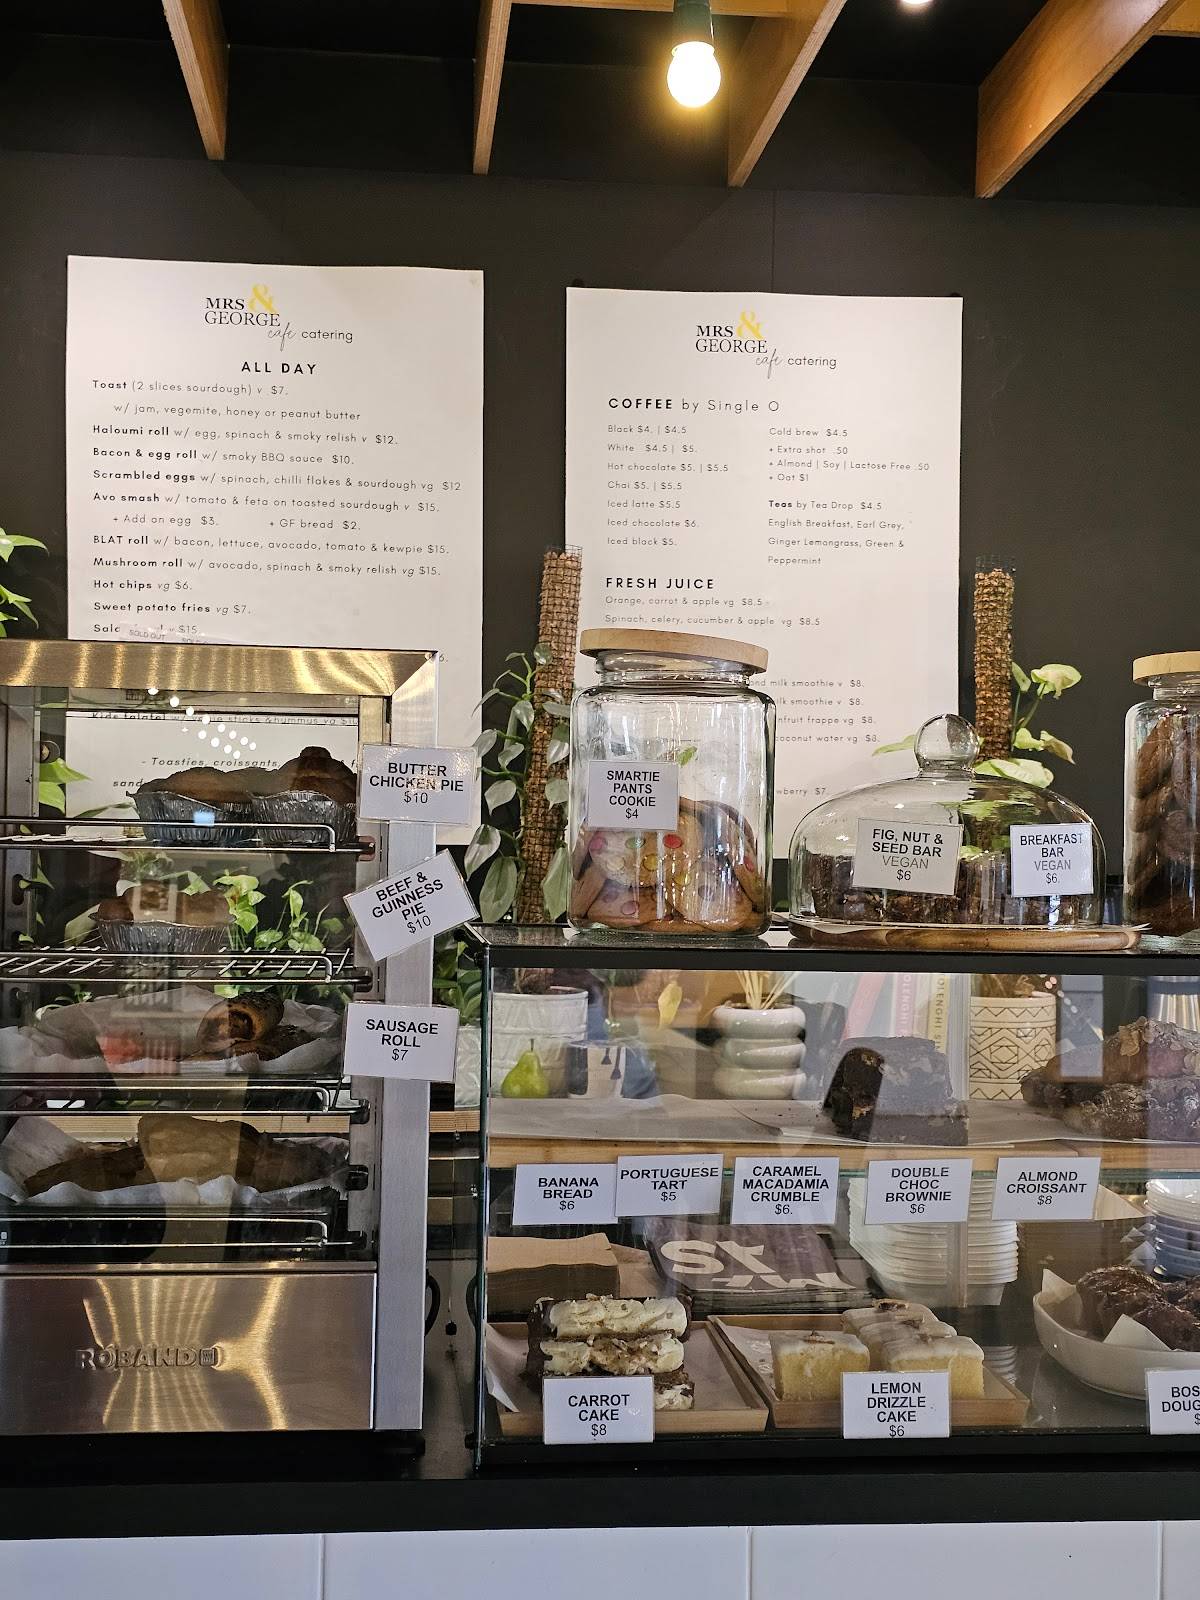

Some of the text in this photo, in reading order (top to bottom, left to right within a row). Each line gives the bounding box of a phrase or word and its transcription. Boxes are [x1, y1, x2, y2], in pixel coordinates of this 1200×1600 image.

[206, 284, 279, 313] MRS &
[204, 312, 280, 327] GEORGE
[696, 310, 764, 340] MRS &
[301, 328, 353, 343] catering
[695, 340, 768, 354] GEORGE
[240, 360, 318, 376] ALL DAY
[787, 355, 837, 369] catering
[92, 379, 128, 390] Toast
[132, 380, 143, 393] (2
[148, 379, 182, 393] slices
[186, 382, 252, 398] sourdough)
[608, 395, 780, 417] COFFEE by Single O
[92, 424, 144, 439] Haloumi
[148, 425, 169, 439] roll
[173, 426, 190, 441] w/
[225, 428, 270, 442] spinach
[274, 430, 281, 440] &
[287, 430, 322, 445] smoky
[325, 431, 357, 444] relish
[769, 426, 848, 439] Cold brew $4.5
[93, 446, 131, 458] Bacon
[136, 448, 143, 458] &
[147, 447, 172, 462] egg
[176, 448, 197, 460] roll
[199, 449, 218, 463] w/
[222, 450, 257, 465] smoky
[261, 451, 285, 463] BBQ
[289, 454, 323, 464] sauce
[607, 498, 681, 510] Iced latte $5.5
[767, 499, 882, 512] Teas by Tea Drop $4.5
[607, 517, 628, 528] Iced
[631, 517, 681, 528] chocolate
[93, 534, 124, 545] BLAT
[128, 534, 149, 546] roll
[153, 535, 169, 549] w/
[325, 540, 368, 552] tomato
[371, 543, 377, 552] &
[383, 541, 423, 557] kewpie
[767, 536, 801, 549] Ginger
[865, 538, 894, 551] Green
[899, 540, 904, 548] &
[93, 578, 115, 592] Hot
[118, 578, 152, 593] chips
[158, 583, 170, 592] vg
[605, 575, 714, 591] FRESH JUICE
[93, 599, 132, 615] Sweet
[136, 602, 177, 615] potato
[181, 601, 211, 614] fries
[216, 606, 232, 617] vg
[388, 762, 447, 776] BUTTER
[607, 770, 660, 782] SMARTIE
[370, 775, 463, 792] CHICKEN PIE
[614, 782, 652, 795] PANTS
[403, 791, 428, 804] $10
[609, 795, 656, 807] COOKIE
[626, 808, 638, 820] $4
[873, 828, 943, 845] FIG, NUT &
[1020, 833, 1082, 846] BREAKFAST
[872, 841, 941, 858] SEED BAR
[1042, 847, 1064, 858] BAR
[883, 854, 928, 870] VEGAN
[1034, 859, 1070, 871] VEGAN
[896, 868, 911, 881] $6
[376, 872, 427, 902] BEEF &
[372, 879, 443, 919] GUINNESS
[402, 902, 425, 921] PIE
[407, 915, 431, 934] $10
[366, 1018, 438, 1035] SAUSAGE
[382, 1033, 420, 1050] ROLL
[392, 1048, 408, 1062] $7
[620, 1167, 719, 1180] PORTUGUESE
[753, 1165, 821, 1177] CARAMEL
[892, 1167, 949, 1178] DOUBLE
[1018, 1171, 1077, 1182] ALMOND
[539, 1177, 599, 1188] BANANA
[651, 1179, 687, 1190] TART
[743, 1178, 829, 1190] MACADAMIA
[900, 1179, 940, 1190] CHOC
[1007, 1183, 1087, 1194] CROISSANT
[543, 1189, 592, 1199] BREAD
[661, 1191, 676, 1202] $5
[751, 1191, 819, 1202] CRUMBLE
[886, 1191, 951, 1202] BROWNIE
[1037, 1194, 1052, 1206] $8
[560, 1200, 574, 1212] $6
[910, 1203, 925, 1214] $6
[76, 1347, 196, 1370] ROBAND
[872, 1381, 921, 1395] LEMON
[1171, 1385, 1200, 1397] BOS
[568, 1394, 630, 1408] CARROT
[868, 1395, 926, 1409] DRIZZLE
[579, 1408, 619, 1422] CAKE
[877, 1410, 916, 1423] CAKE
[591, 1423, 606, 1437] $8
[888, 1425, 905, 1438] $6
